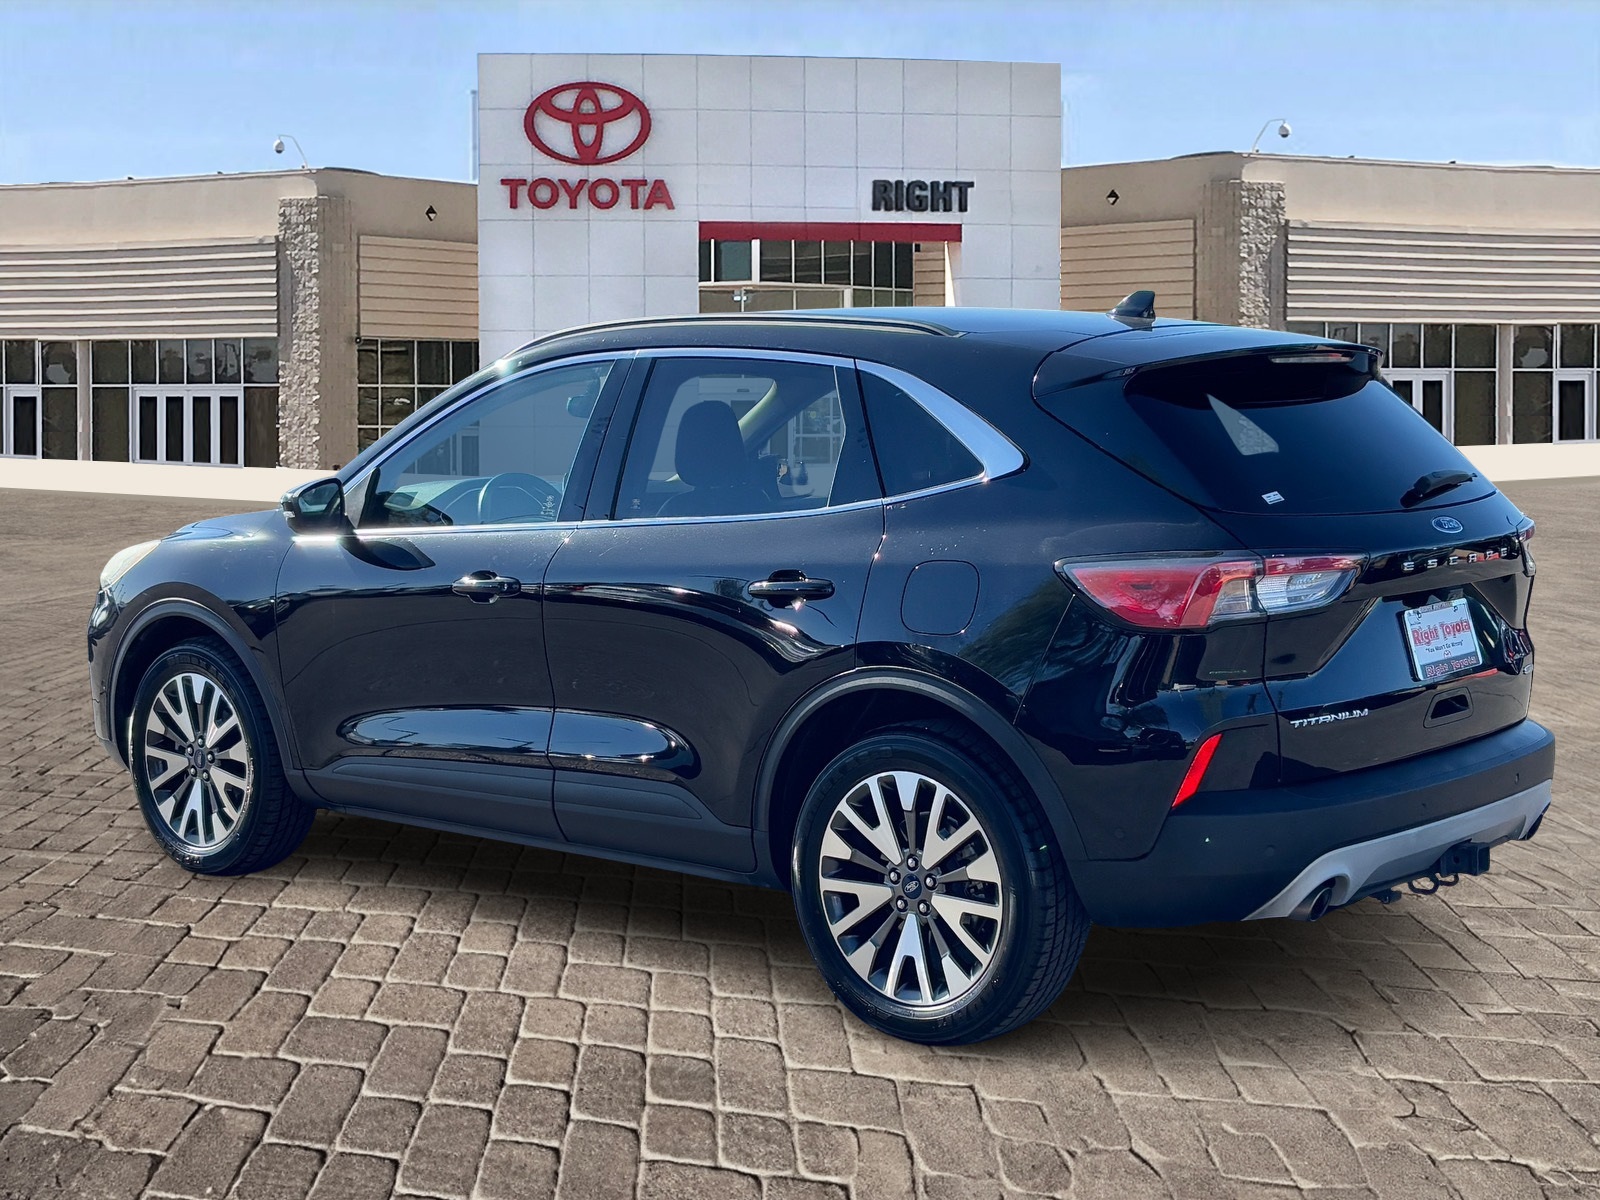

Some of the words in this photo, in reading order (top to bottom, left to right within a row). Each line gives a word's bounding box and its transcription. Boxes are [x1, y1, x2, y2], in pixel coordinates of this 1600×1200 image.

[500, 178, 675, 210] TOYOTA
[871, 179, 975, 214] RIGHT
[1402, 547, 1508, 571] ESCAPE
[1412, 626, 1439, 646] Right
[1440, 619, 1470, 637] Toyota
[1425, 664, 1449, 677] Right
[1290, 708, 1369, 729] TITANIUM
